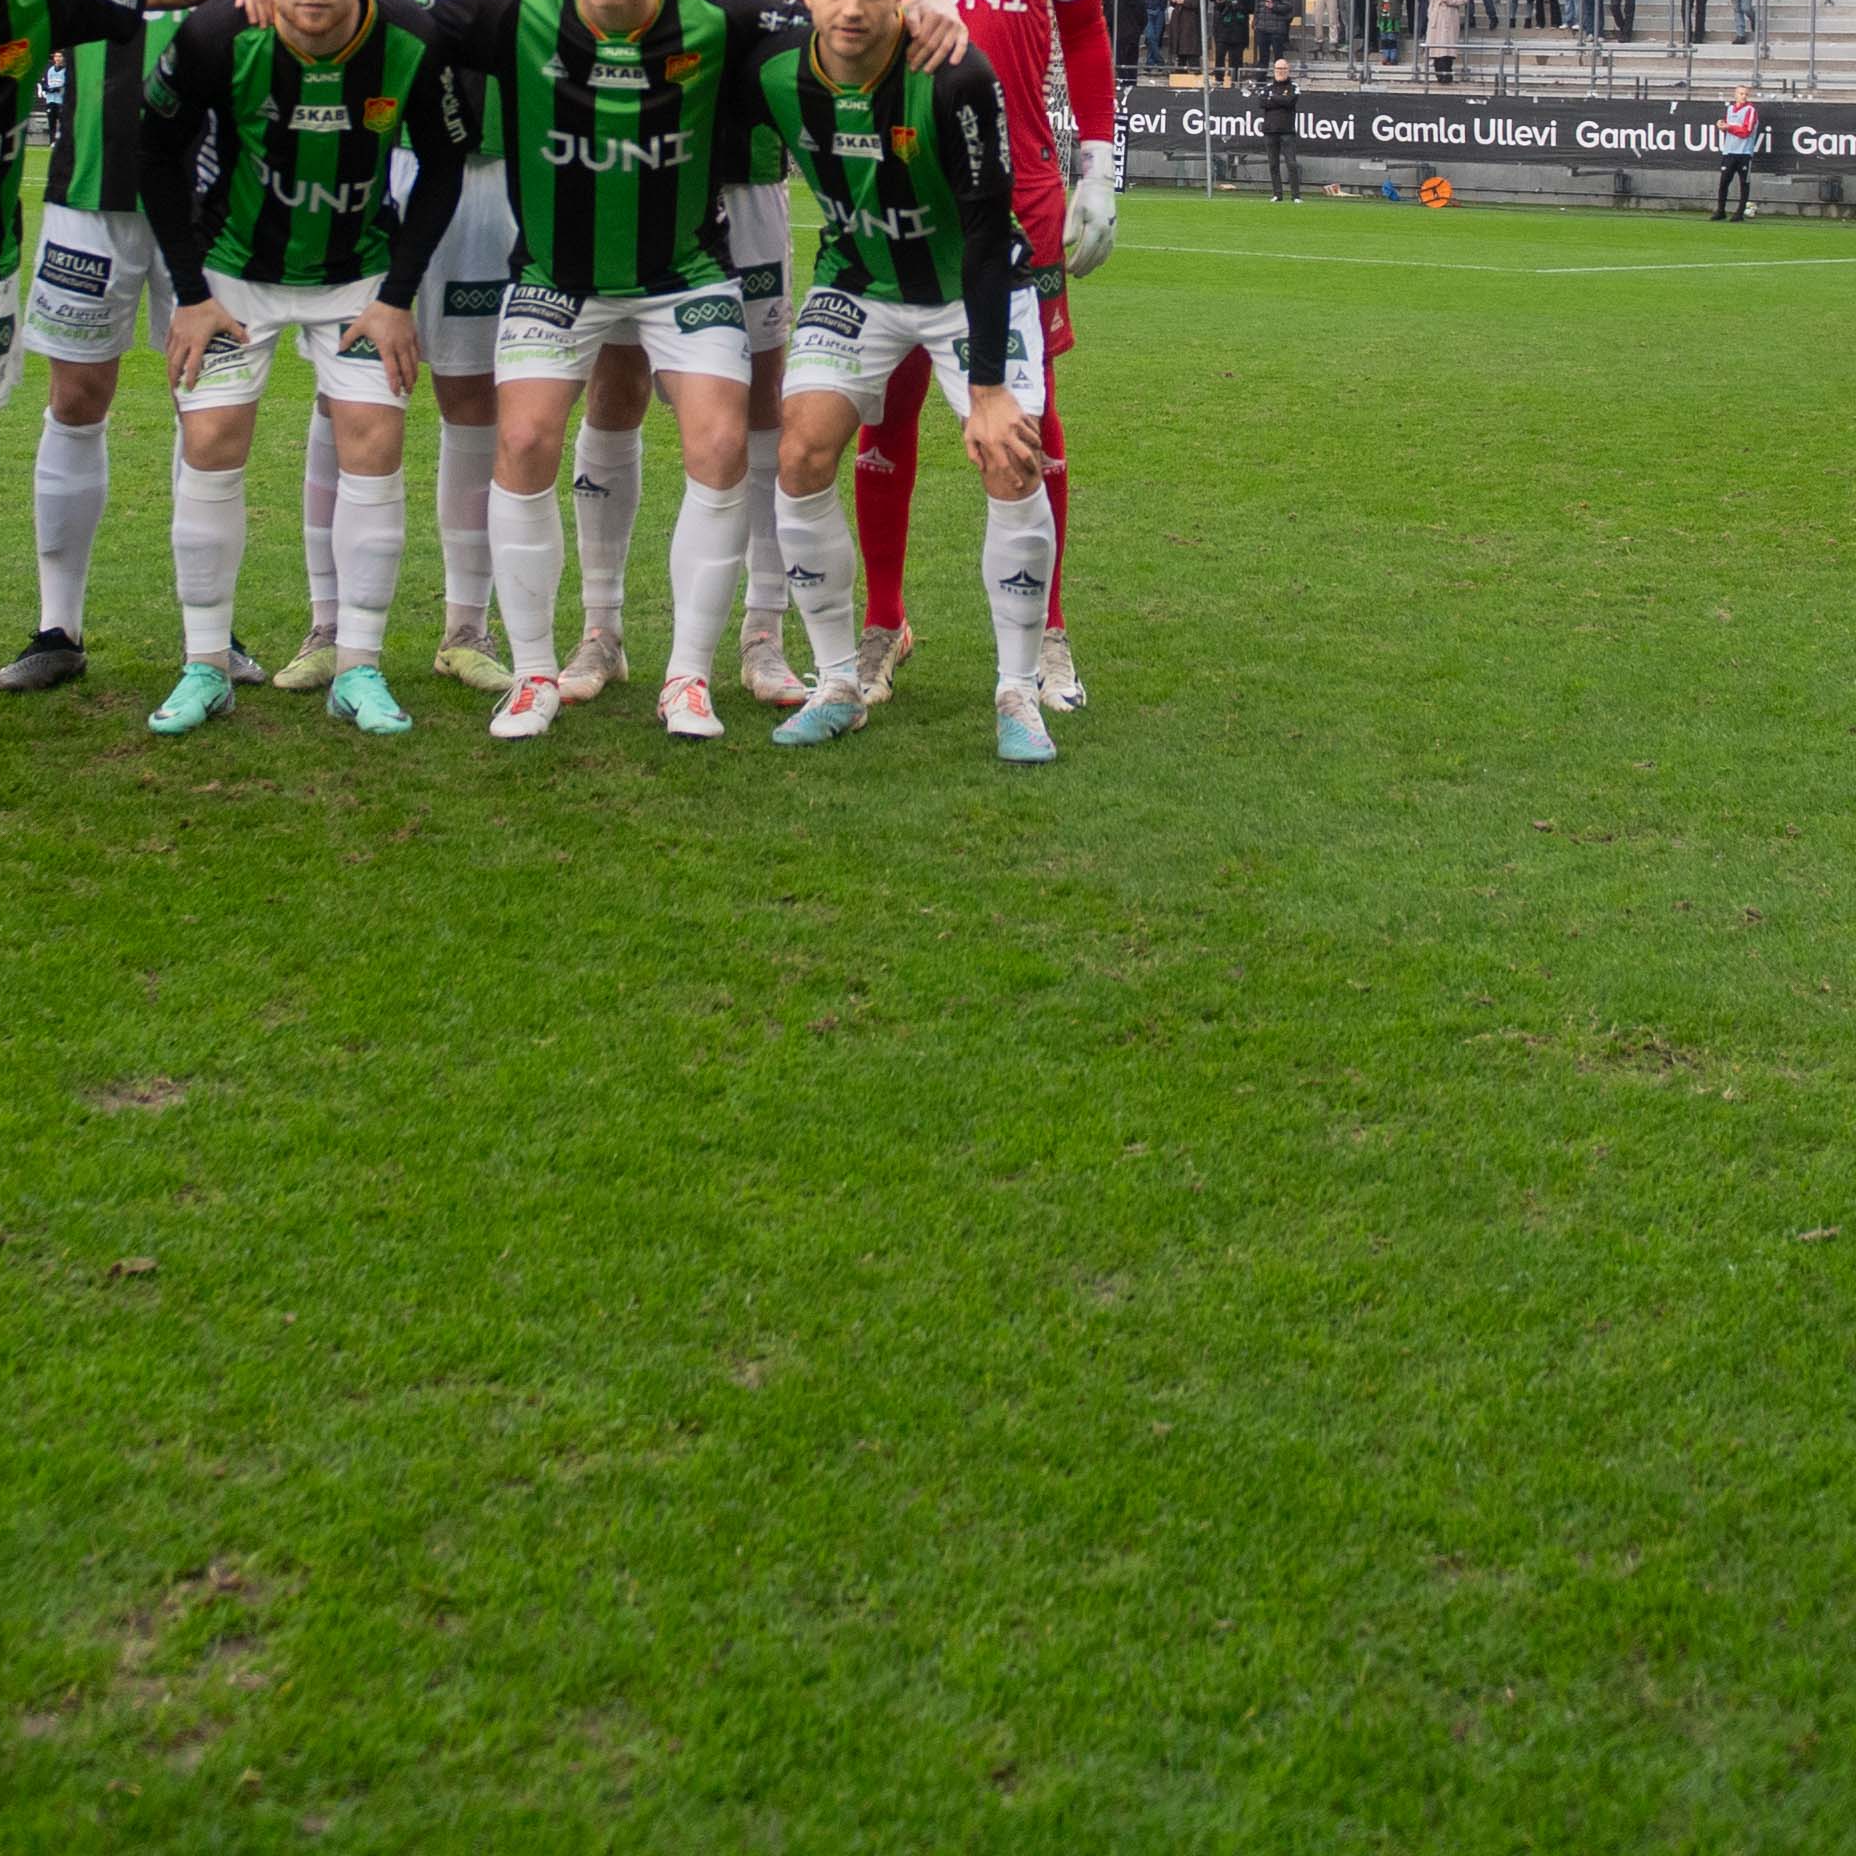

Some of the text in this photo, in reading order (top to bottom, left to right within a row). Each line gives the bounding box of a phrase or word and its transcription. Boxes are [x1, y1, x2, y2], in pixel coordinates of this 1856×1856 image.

[594, 66, 643, 79] SKAB
[294, 107, 345, 122] SKAB
[1129, 108, 1167, 134] evi
[1296, 111, 1355, 140] llevi
[835, 135, 882, 150] SKAB
[1372, 114, 1557, 147] Gamla Ullevi
[1575, 120, 1675, 151] Gamla
[541, 131, 693, 172] JUNI
[257, 156, 378, 214] JUNI
[816, 191, 936, 240] JUNI
[47, 247, 105, 276] VIRTUAL
[514, 286, 577, 311] VIRTUAL
